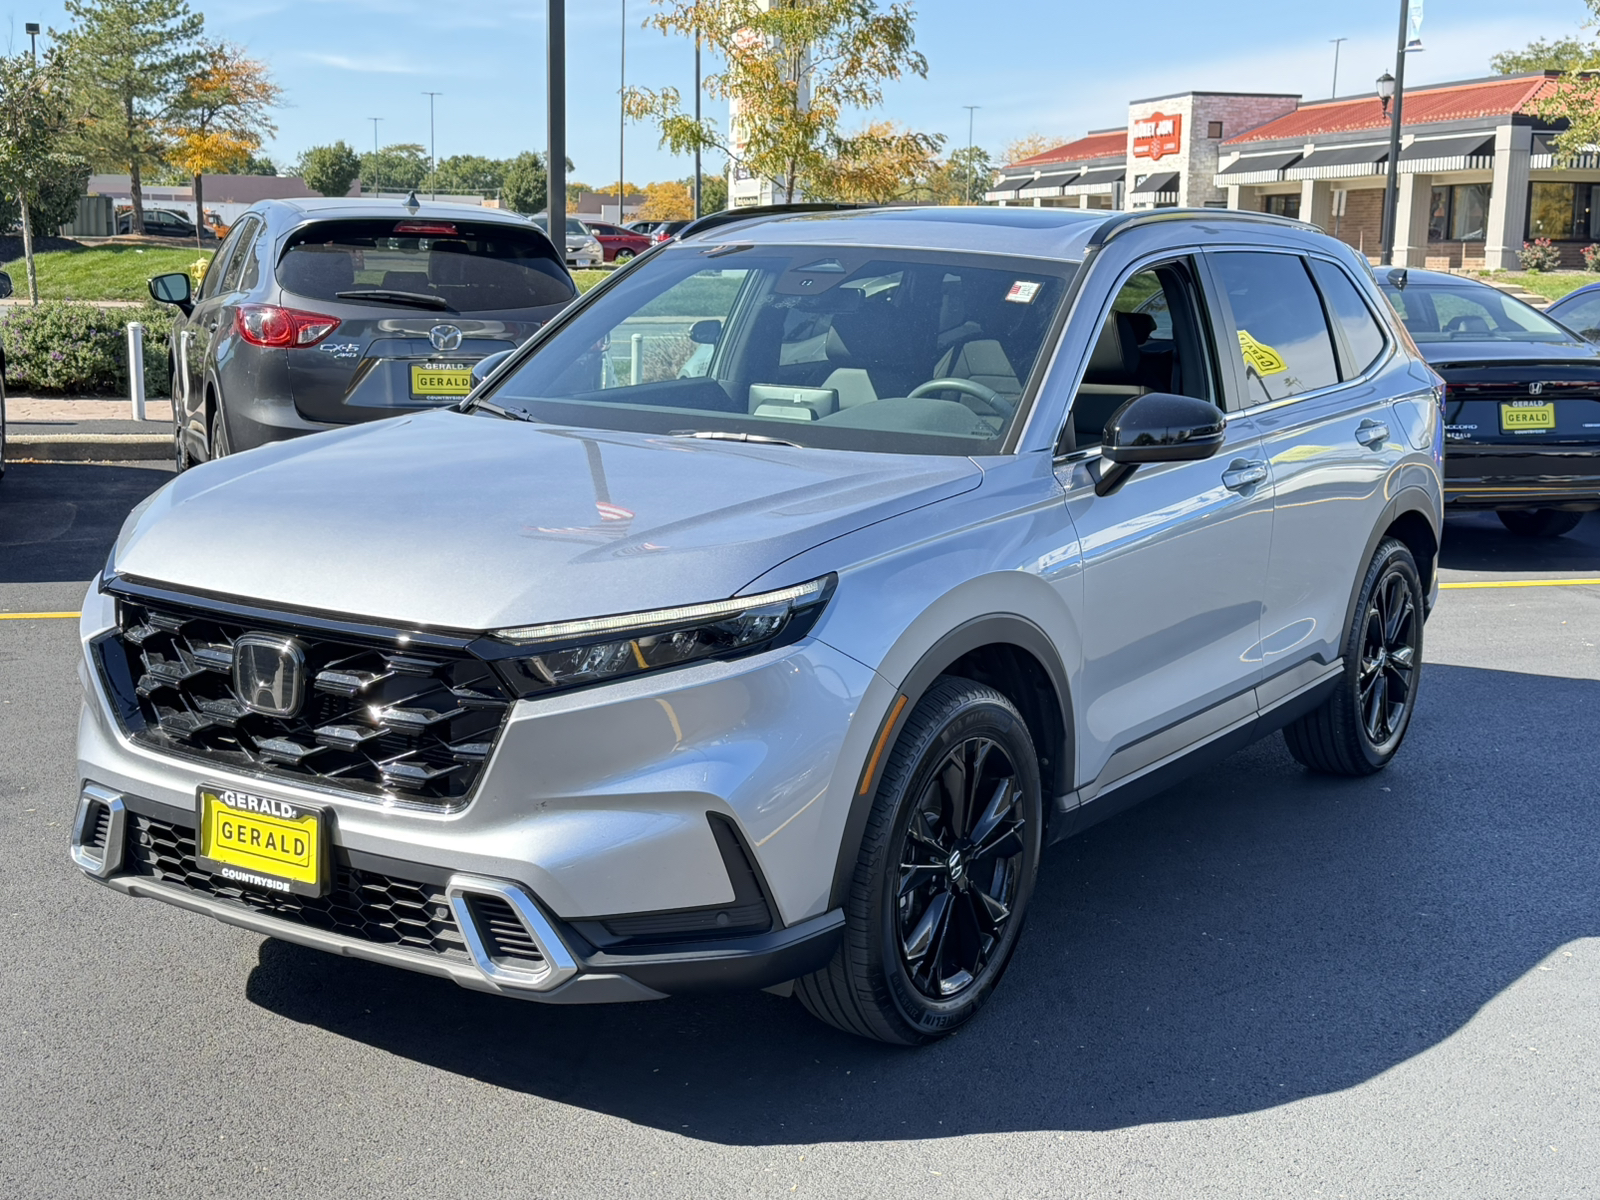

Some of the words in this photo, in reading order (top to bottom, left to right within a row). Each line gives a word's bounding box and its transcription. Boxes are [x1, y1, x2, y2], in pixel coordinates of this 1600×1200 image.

[425, 362, 464, 370] GERALD
[420, 377, 469, 387] GERALD
[1508, 413, 1548, 422] GERALD
[224, 790, 293, 819] GERALD
[221, 821, 305, 857] GERALD
[221, 868, 290, 892] COUNTRYSIDE
